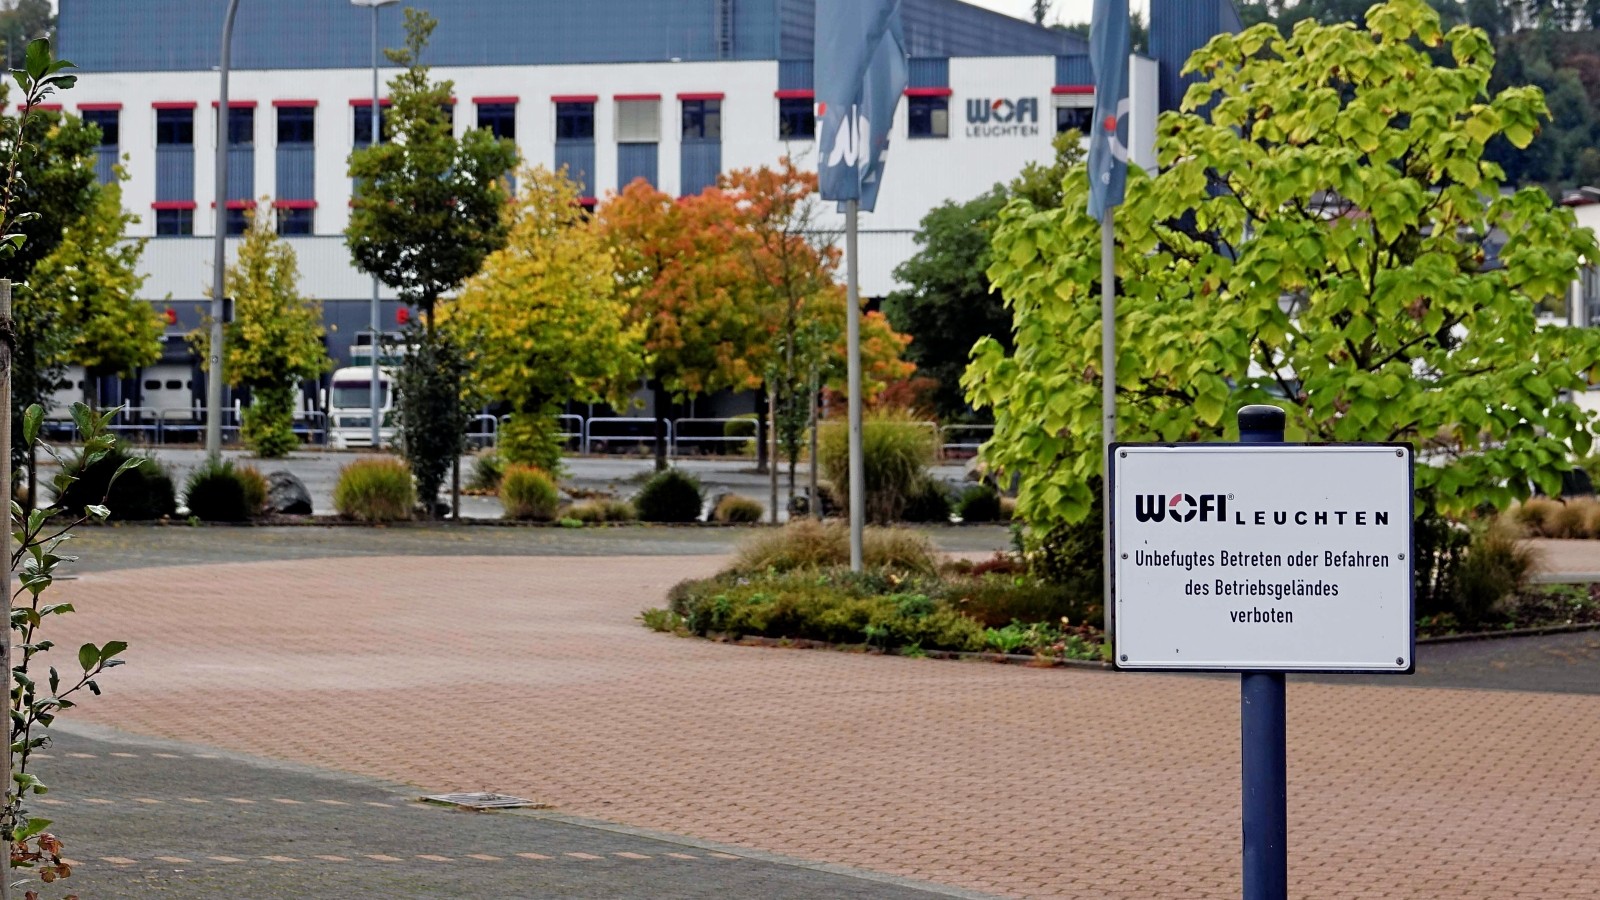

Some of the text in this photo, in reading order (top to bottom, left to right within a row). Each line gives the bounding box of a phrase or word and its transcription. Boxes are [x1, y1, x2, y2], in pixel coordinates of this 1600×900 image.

[966, 97, 1038, 123] WOFI
[966, 125, 1038, 137] LEUCHTEN
[1236, 511, 1389, 526] LEUCHTEN
[1136, 550, 1389, 571] Unbefugtes Betreten oder Befahren
[1186, 579, 1339, 600] des Betriebsgeländes
[1230, 607, 1293, 623] verboten
